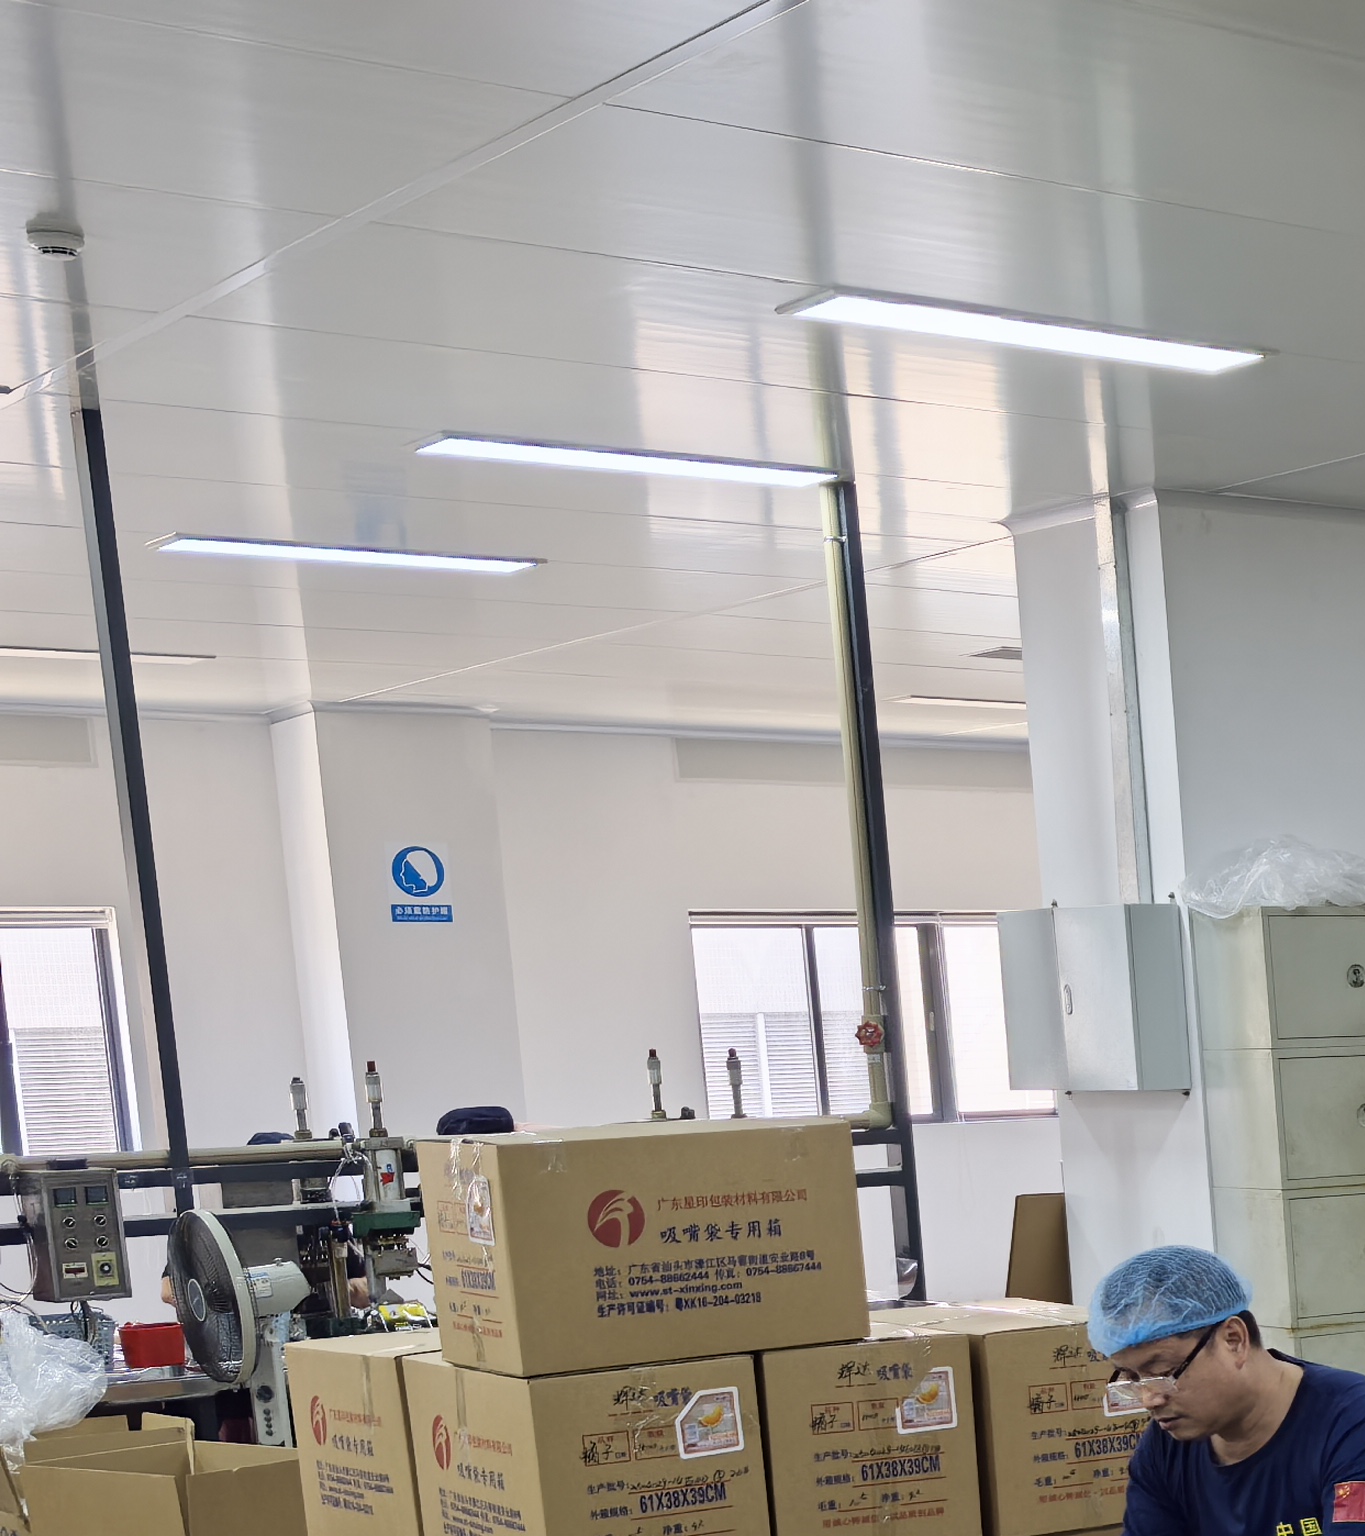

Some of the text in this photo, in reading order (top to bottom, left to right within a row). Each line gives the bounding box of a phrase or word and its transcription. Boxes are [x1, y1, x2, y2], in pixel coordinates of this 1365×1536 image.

[660, 1219, 782, 1244] 吸嘴袋专用箱
[861, 1454, 941, 1482] 61X38X39CM
[639, 1482, 727, 1514] 61X38X39CM
